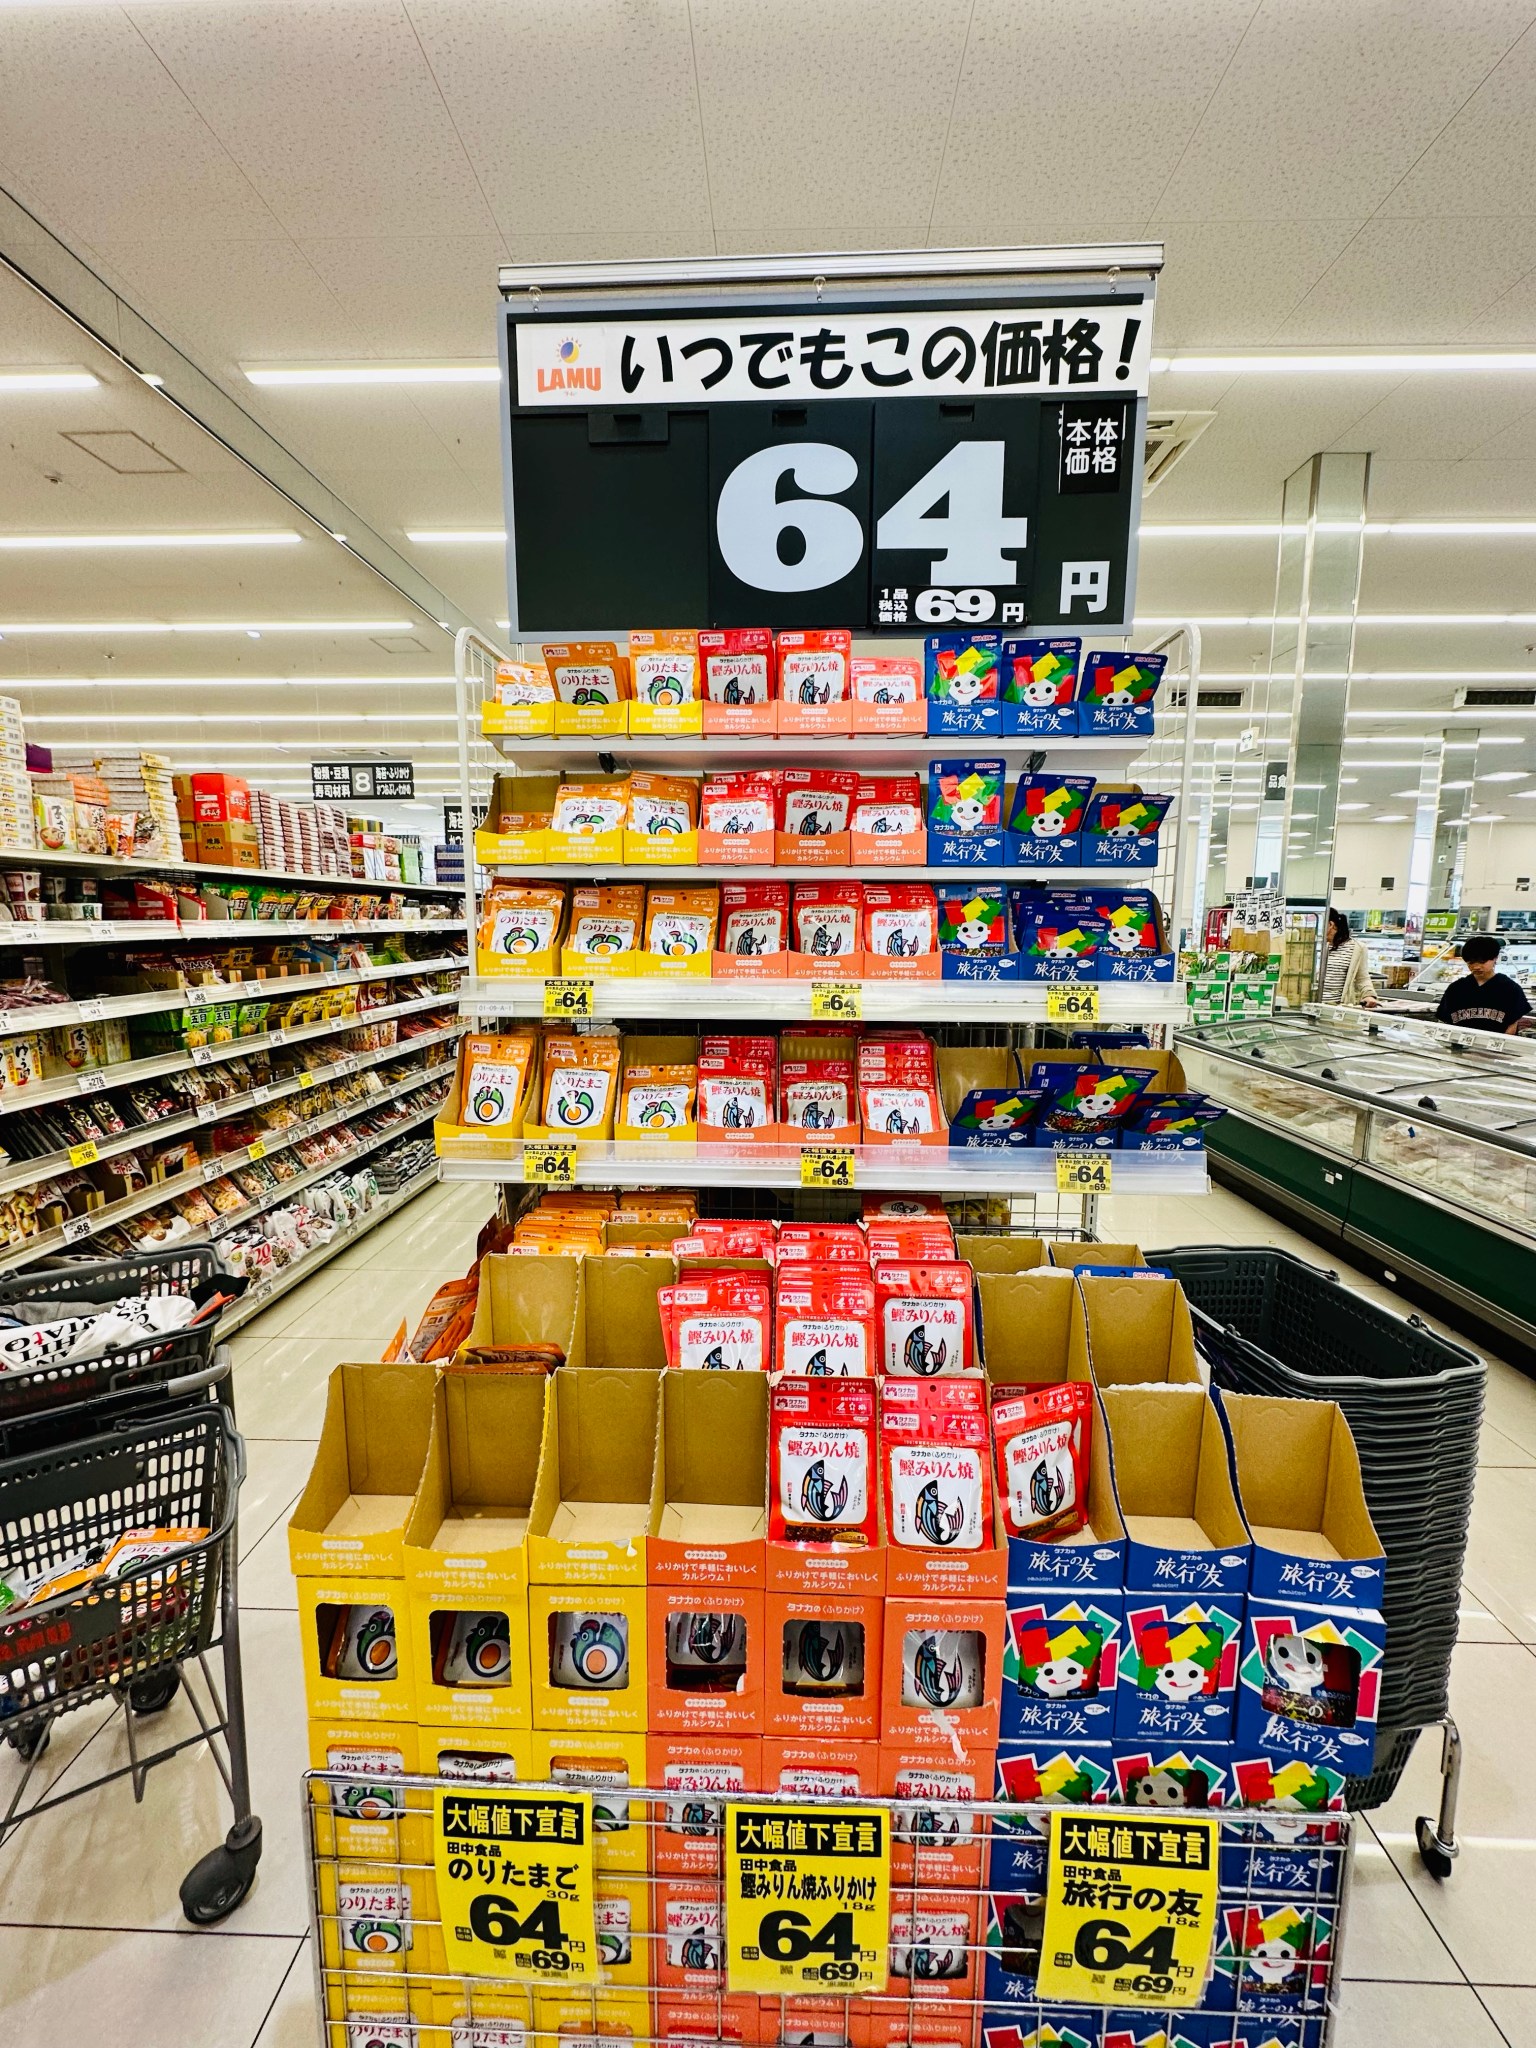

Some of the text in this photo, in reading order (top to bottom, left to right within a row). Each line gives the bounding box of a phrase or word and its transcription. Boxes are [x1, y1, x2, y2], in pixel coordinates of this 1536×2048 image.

[537, 318, 1142, 393] LAMU いつでもこの価格！
[1066, 418, 1118, 446] 本体
[1065, 447, 1116, 475] 価格
[716, 441, 1110, 614] 64 円
[881, 589, 908, 599] 1品
[879, 600, 907, 610] 税込
[915, 589, 1024, 622] 69 円
[879, 612, 907, 622] 価格
[640, 663, 688, 673] のりたまご
[712, 663, 763, 676] 鰹みりん焼
[789, 661, 838, 673] 鰹みりん焼
[561, 674, 609, 686] のりたまご
[942, 710, 986, 731] 旅行の友
[1017, 711, 1061, 731] 旅行の友
[1094, 709, 1137, 729] 旅行の友
[356, 772, 370, 792] 8
[792, 800, 843, 812] 鰹みりん焼
[943, 842, 986, 862] 旅行の友
[1020, 842, 1064, 863] 旅行の友
[1098, 841, 1141, 862] 旅行の友
[501, 914, 547, 926] のりたまご
[583, 923, 629, 933] のりたまご
[731, 917, 776, 927] 鰹みりん焼
[1111, 961, 1157, 982] 旅行の友
[563, 992, 588, 1007] 64
[831, 995, 856, 1010] 64
[1067, 997, 1093, 1012] 64
[473, 1072, 513, 1086] のりたまご
[711, 1084, 761, 1096] 鰹みりん焼
[792, 1088, 842, 1102] 鰹みりん焼
[544, 1157, 570, 1173] 64
[821, 1160, 848, 1177] 64
[1078, 1166, 1105, 1183] 64
[76, 1222, 90, 1234] 88
[256, 1244, 272, 1264] 20
[891, 1308, 957, 1324] 鰹みりん焼
[688, 1330, 754, 1344] 鰹みりん焼
[792, 1332, 859, 1347] 鰹みりん焼
[788, 1440, 859, 1458] 鰹みりん焼
[899, 1459, 974, 1479] 鰹みりん焼
[655, 1563, 757, 1574] ふりかけで手軽においしく
[1028, 1550, 1098, 1582] 旅行の友
[1153, 1558, 1224, 1589] 旅行の友
[682, 1572, 731, 1582] カルシウム！
[776, 1570, 878, 1583] ふりかけで手軽においしく
[896, 1572, 999, 1585] ふりかけで手軽においしく
[1281, 1564, 1356, 1599] 旅行の友
[802, 1580, 852, 1590] カルシウム！
[922, 1583, 972, 1592] カルシウム！
[657, 1710, 756, 1720] ふりかけで手軽においしく
[773, 1714, 872, 1725] ふりかけで手軽においしく
[1020, 1706, 1089, 1735] 旅行の友
[1139, 1706, 1208, 1736] 旅行の友
[1266, 1717, 1343, 1763] 旅行の友
[446, 1803, 579, 1840] 大幅値下宣言
[740, 1819, 877, 1853] 大幅値下宣言
[1065, 1824, 1206, 1864] 大幅値下宣言
[447, 1841, 502, 1857] 田中食品
[740, 1859, 797, 1872] 田中食品
[449, 1858, 579, 1890] のりたまご
[1063, 1866, 1122, 1882] 田中食品
[546, 1890, 580, 1901] 30g
[740, 1874, 877, 1901] 鰹みりん焼ふりかけ
[842, 1901, 877, 1912] 18g
[1062, 1882, 1203, 1917] 旅行の友
[469, 1894, 570, 1950] 64
[569, 1941, 585, 1952] 円
[1164, 1916, 1201, 1928] 18g
[758, 1910, 860, 1962] 64
[860, 1951, 876, 1961] 円
[1074, 1920, 1179, 1975] 64
[1176, 1966, 1194, 1978] 円
[532, 1950, 570, 1970] 69
[572, 1963, 584, 1972] 円
[820, 1962, 859, 1980] 69
[860, 1972, 873, 1980] 円
[1132, 1975, 1174, 1994] 69
[1172, 1986, 1186, 1995] 円
